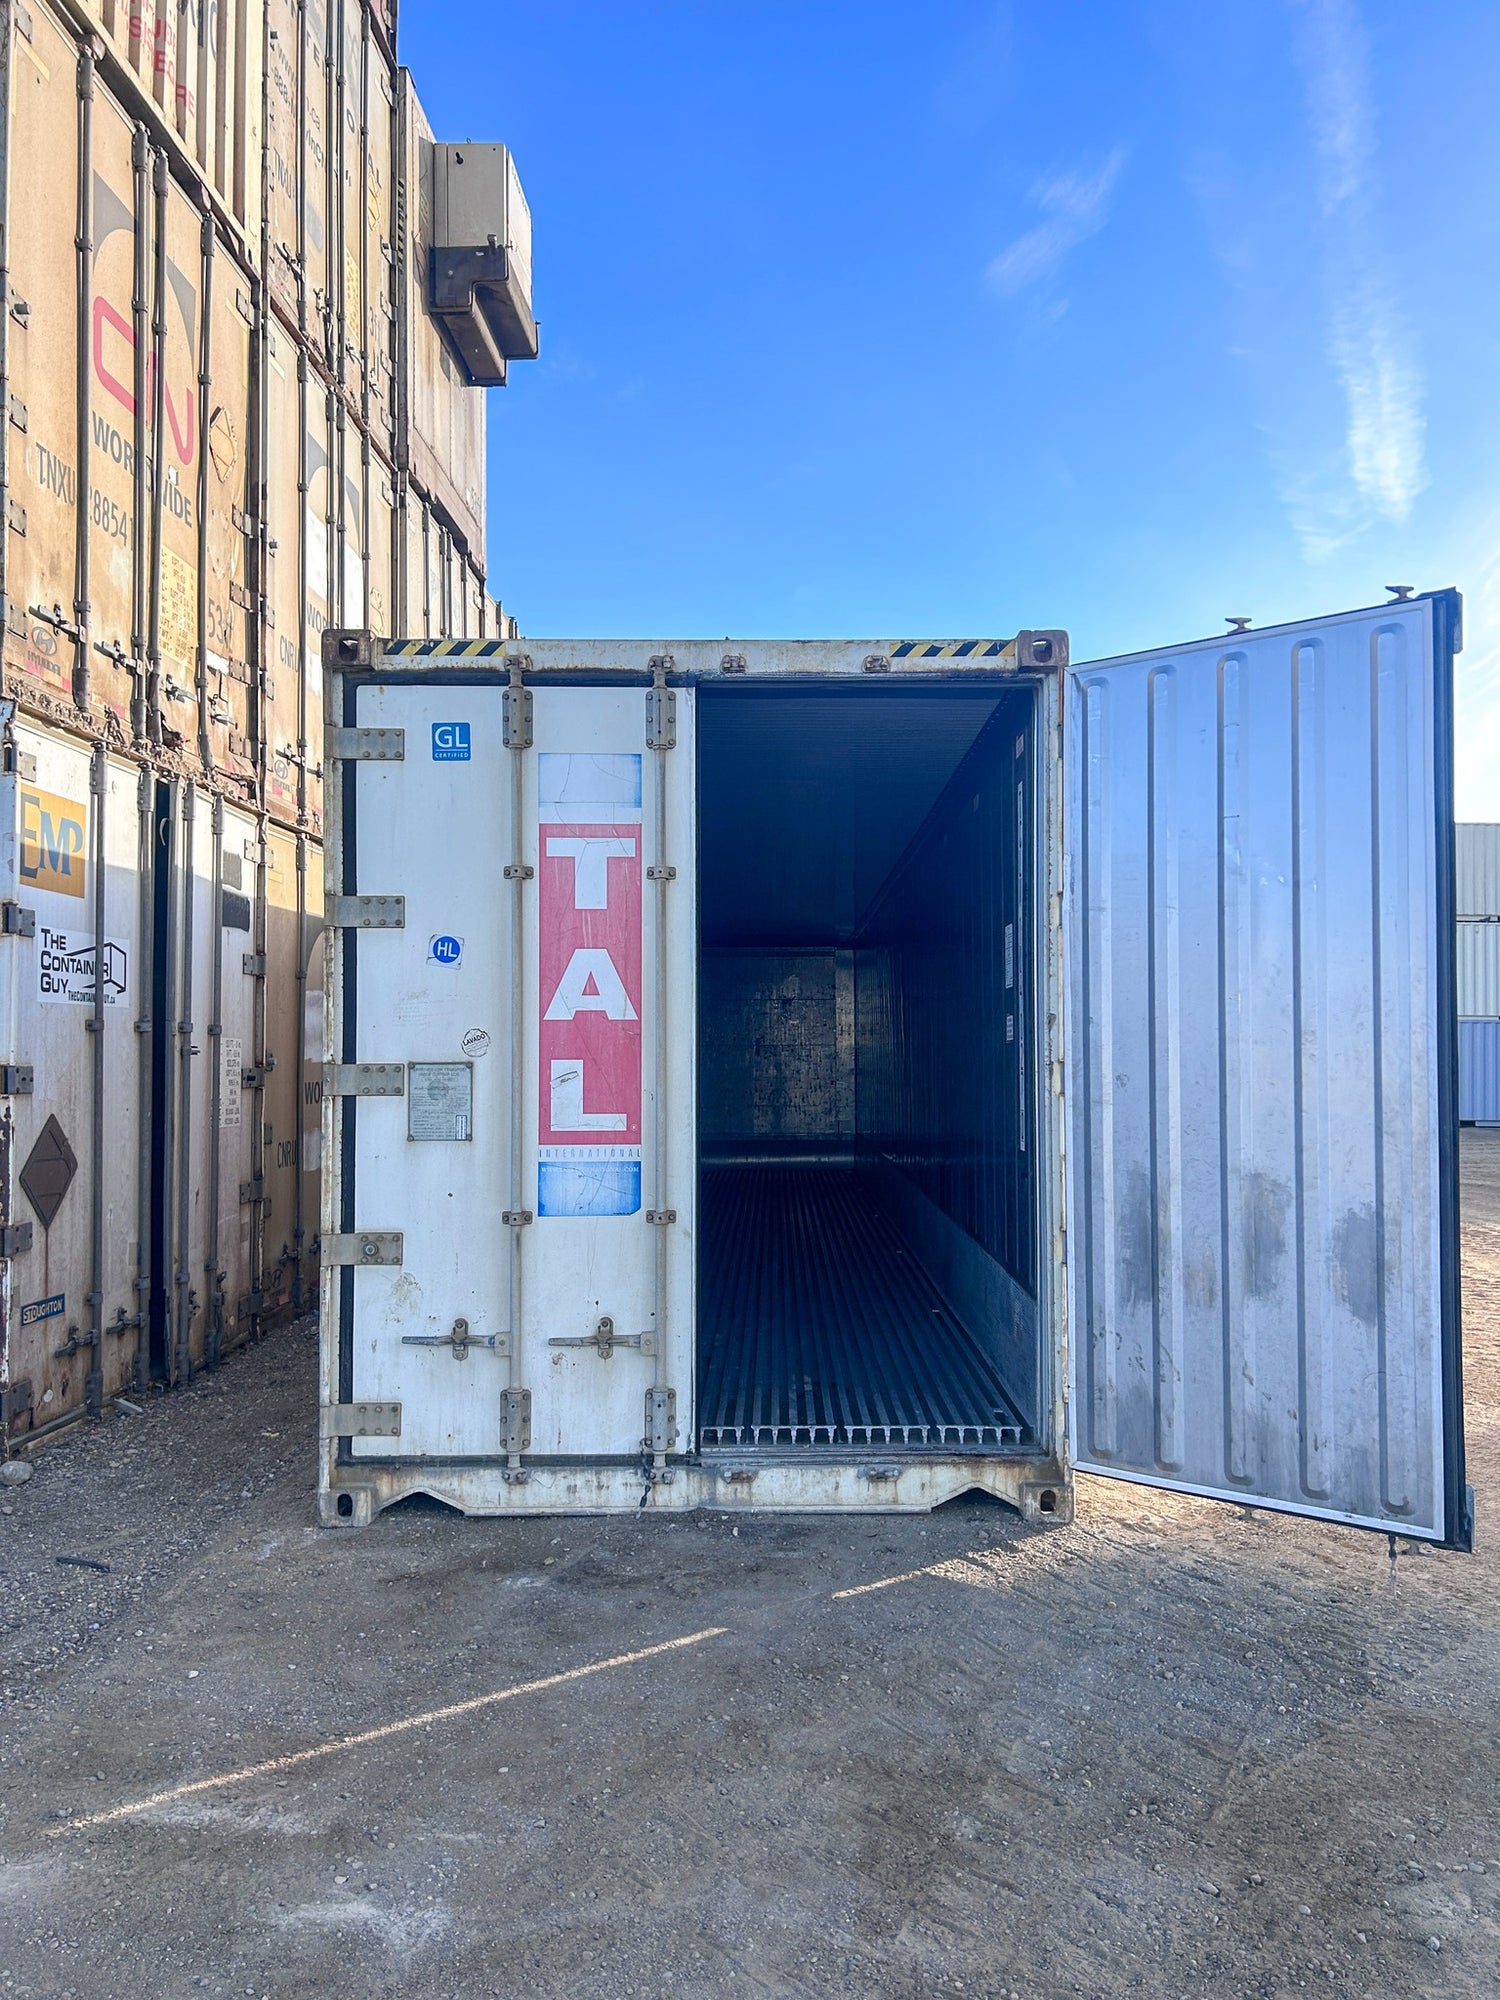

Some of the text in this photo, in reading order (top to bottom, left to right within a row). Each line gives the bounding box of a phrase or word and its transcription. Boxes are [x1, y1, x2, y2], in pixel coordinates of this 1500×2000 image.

[36, 442, 76, 506] TNXU
[434, 726, 469, 748] GL
[20, 791, 83, 879] EMP
[437, 942, 457, 957] HL
[462, 1034, 486, 1046] LAVADO
[540, 1148, 640, 1158] INTERNATIONAL
[23, 1300, 63, 1322] STOUGHTON
